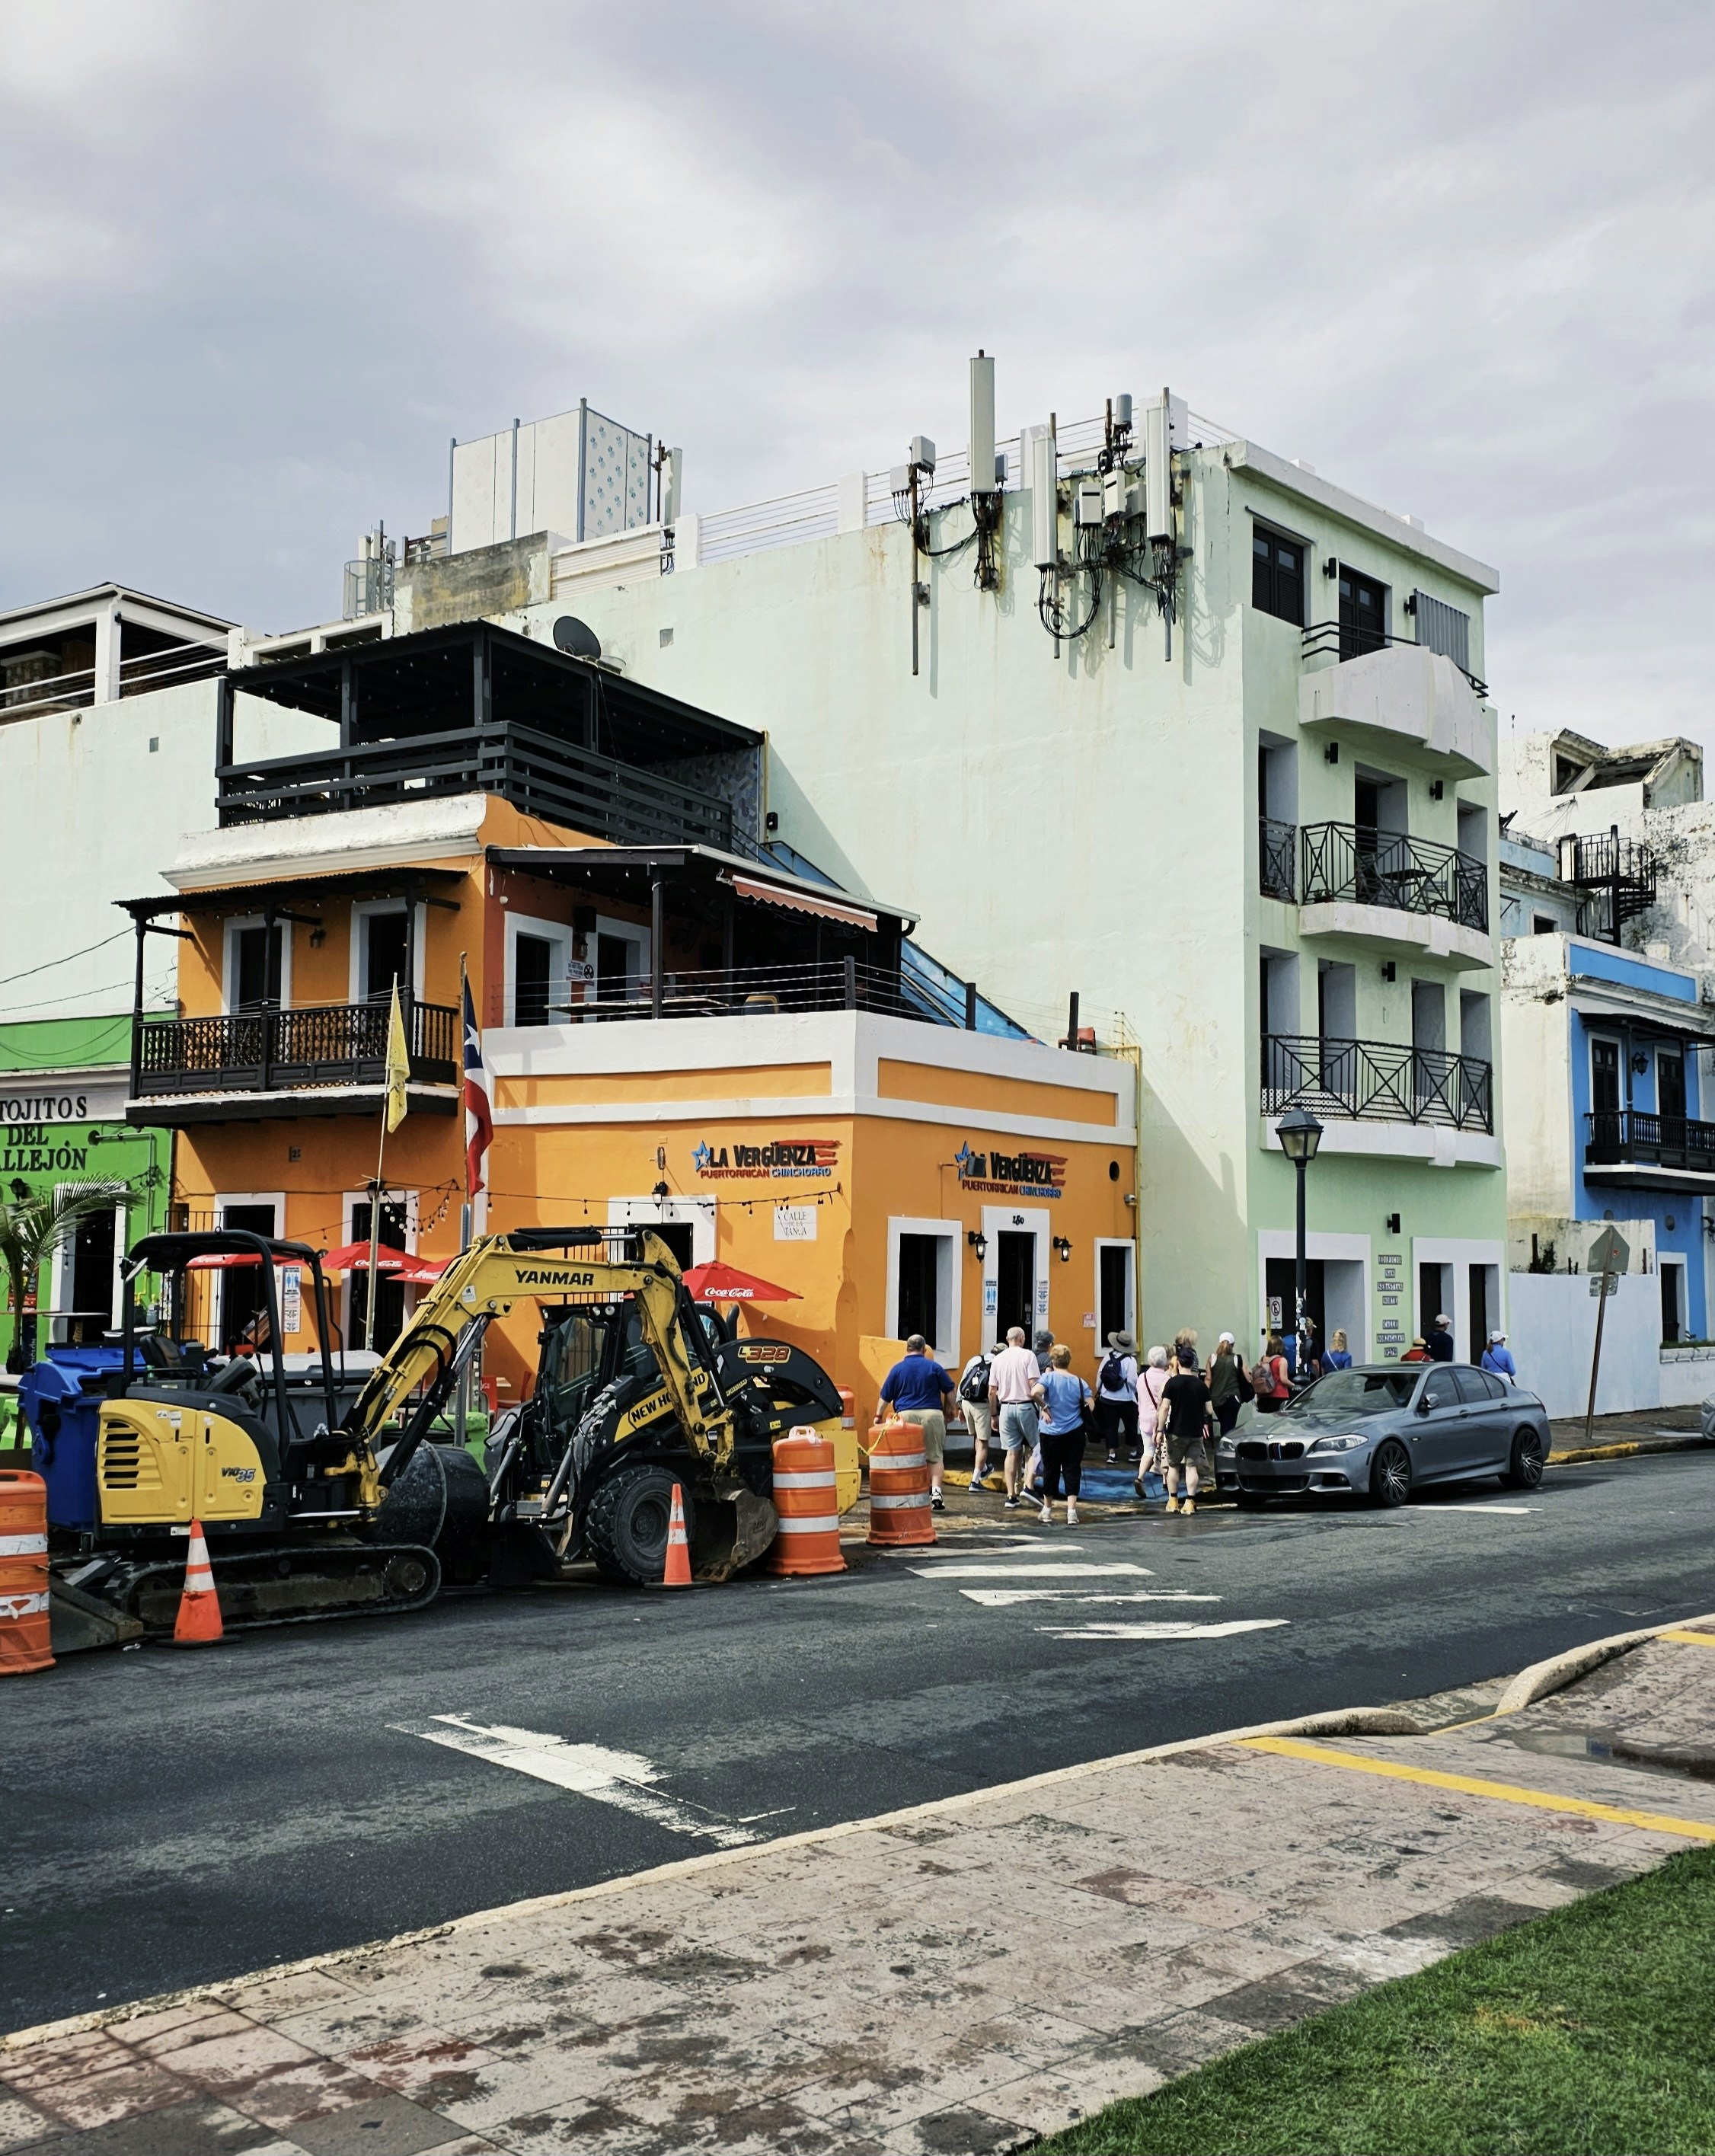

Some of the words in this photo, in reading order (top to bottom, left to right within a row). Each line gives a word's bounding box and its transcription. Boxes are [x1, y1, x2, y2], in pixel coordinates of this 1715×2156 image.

[7, 1125, 49, 1146] DEL
[0, 1140, 88, 1172] LLEJÓN
[709, 1147, 729, 1168] LA
[700, 1169, 770, 1179] PUERTORRICAN
[771, 1167, 832, 1177] CHINCHORRO
[963, 1180, 1019, 1194] PUERTORRICAN
[1019, 1186, 1062, 1199] CHINCHORRO
[784, 1211, 807, 1221] CALLE
[515, 1270, 594, 1286] YANMAR
[704, 1287, 755, 1298] Coca-Cola
[631, 1400, 656, 1423] NEW
